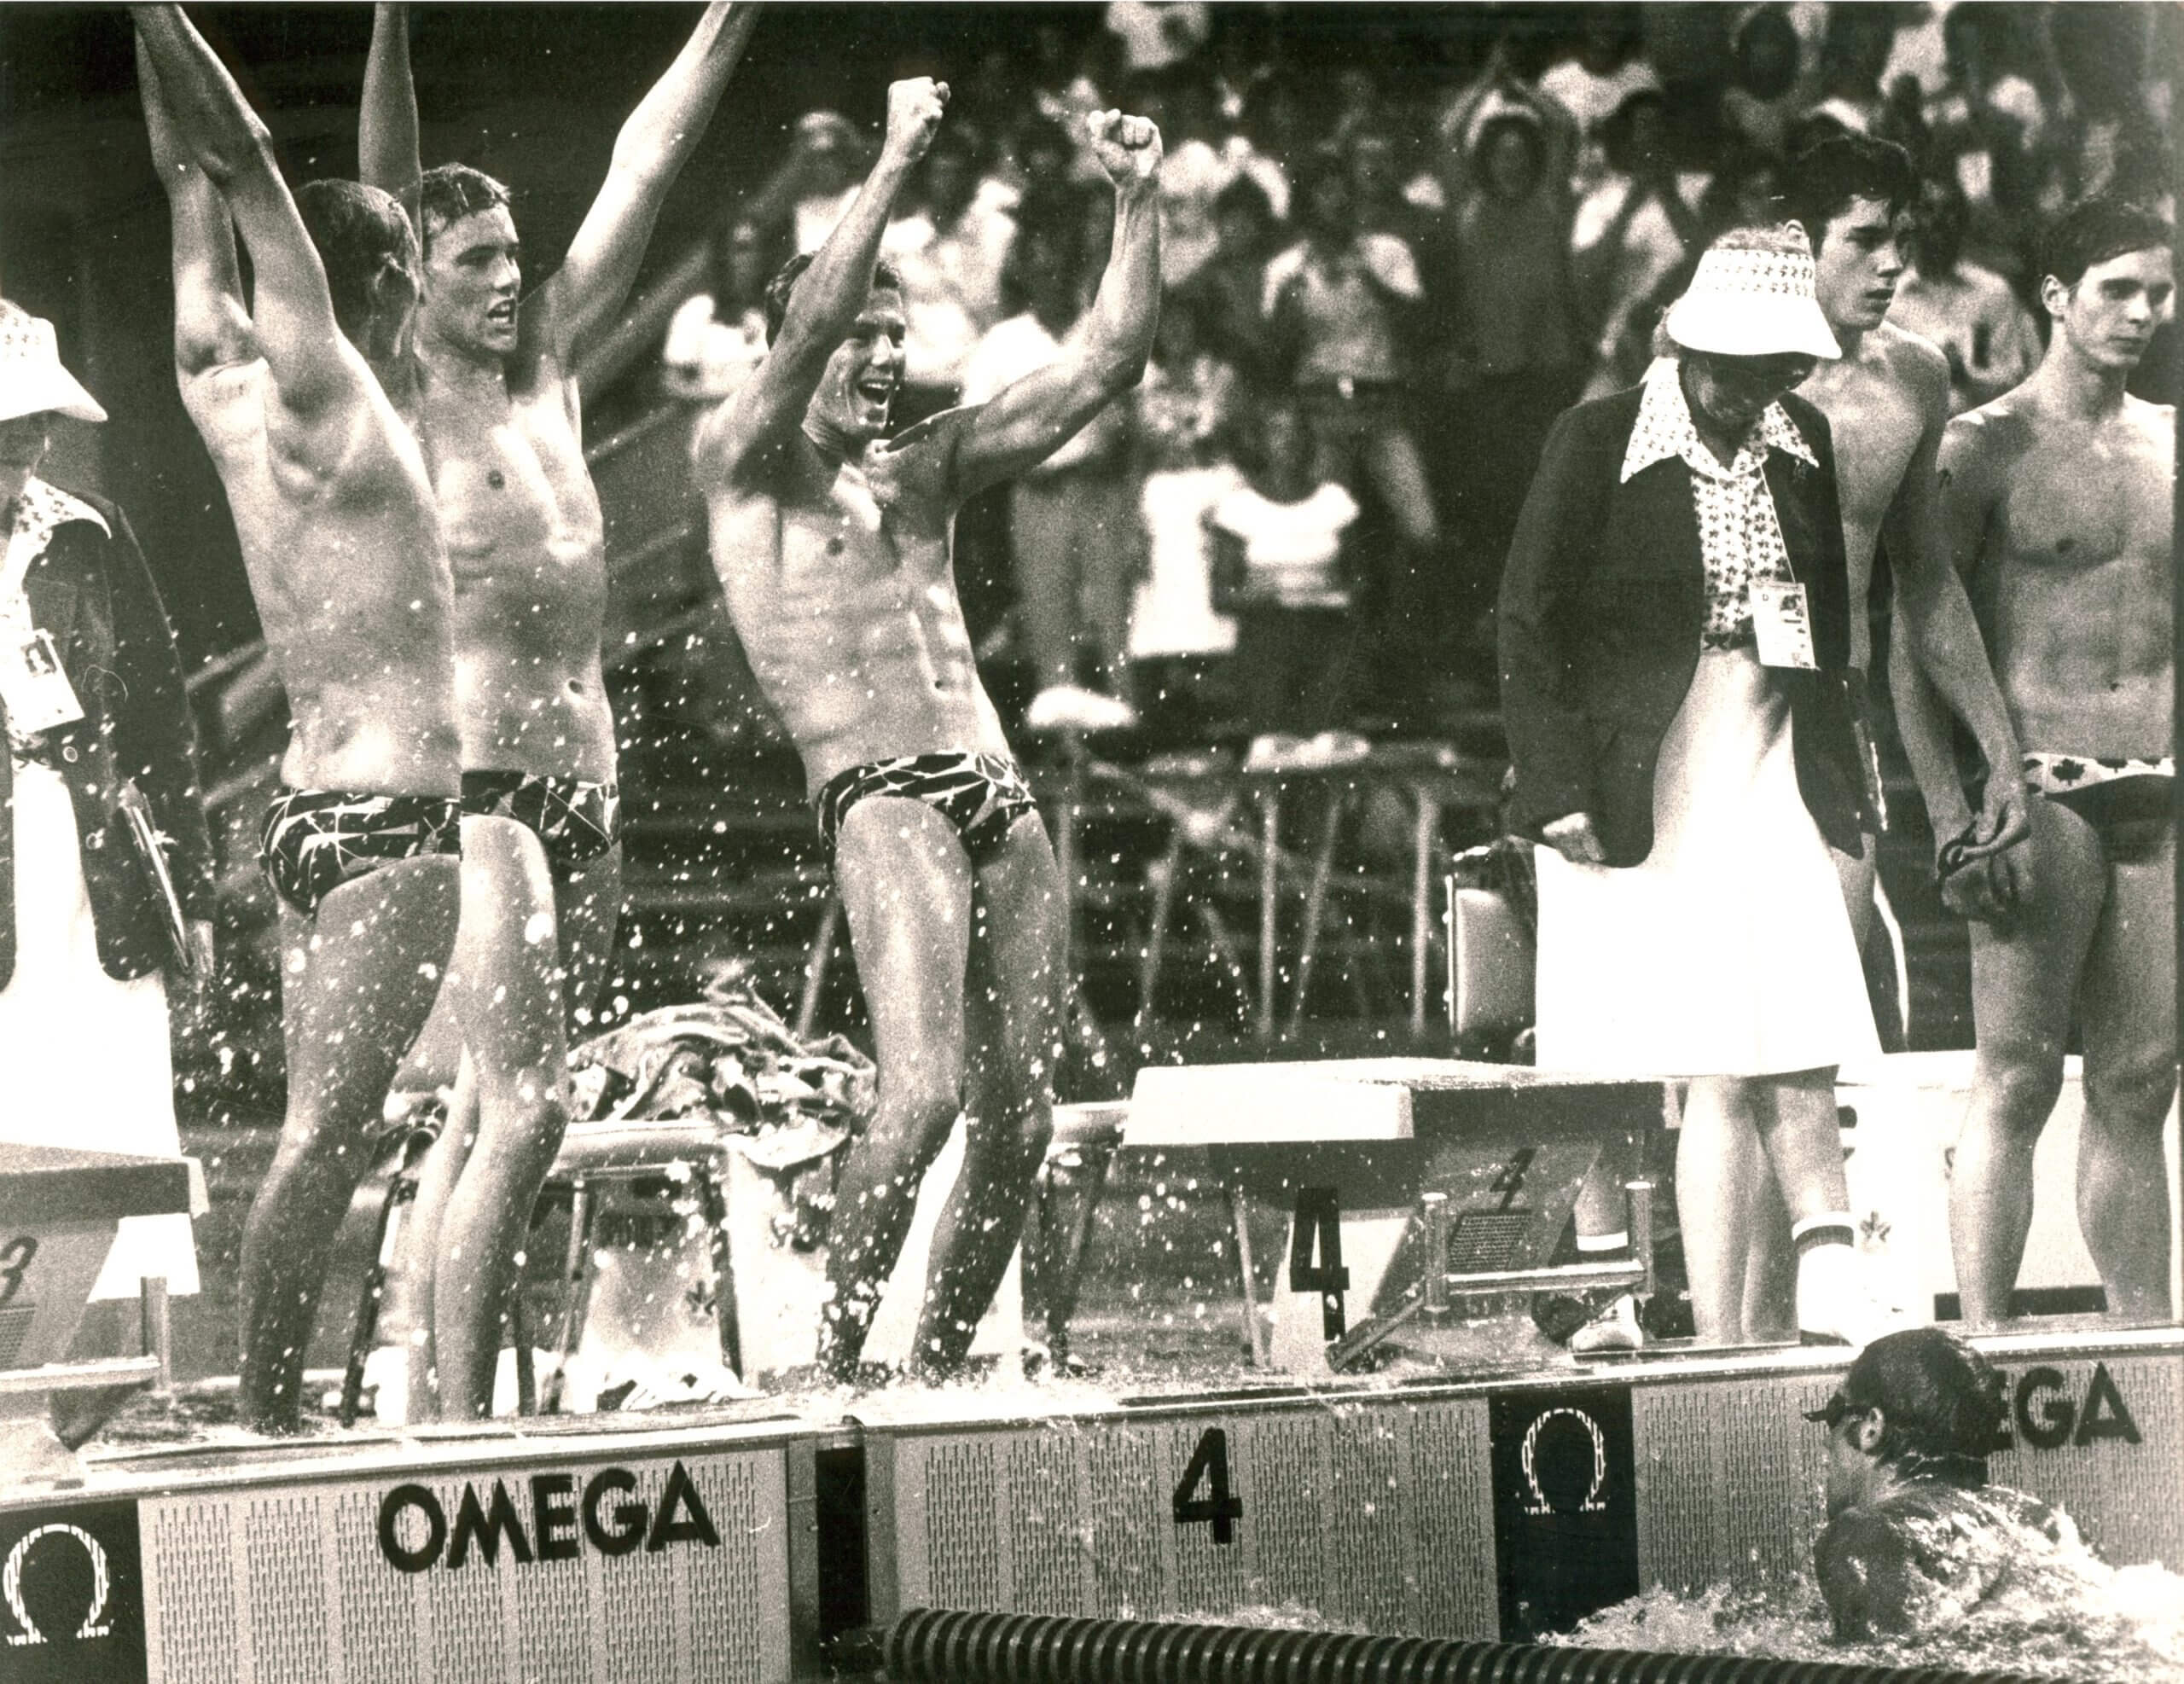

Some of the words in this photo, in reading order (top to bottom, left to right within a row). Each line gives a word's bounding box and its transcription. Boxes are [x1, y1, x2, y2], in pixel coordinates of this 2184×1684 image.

[1490, 1149, 1536, 1212] 4
[1289, 1188, 1350, 1341] 4
[378, 1460, 721, 1573] OMEGA
[1173, 1427, 1243, 1544] 4
